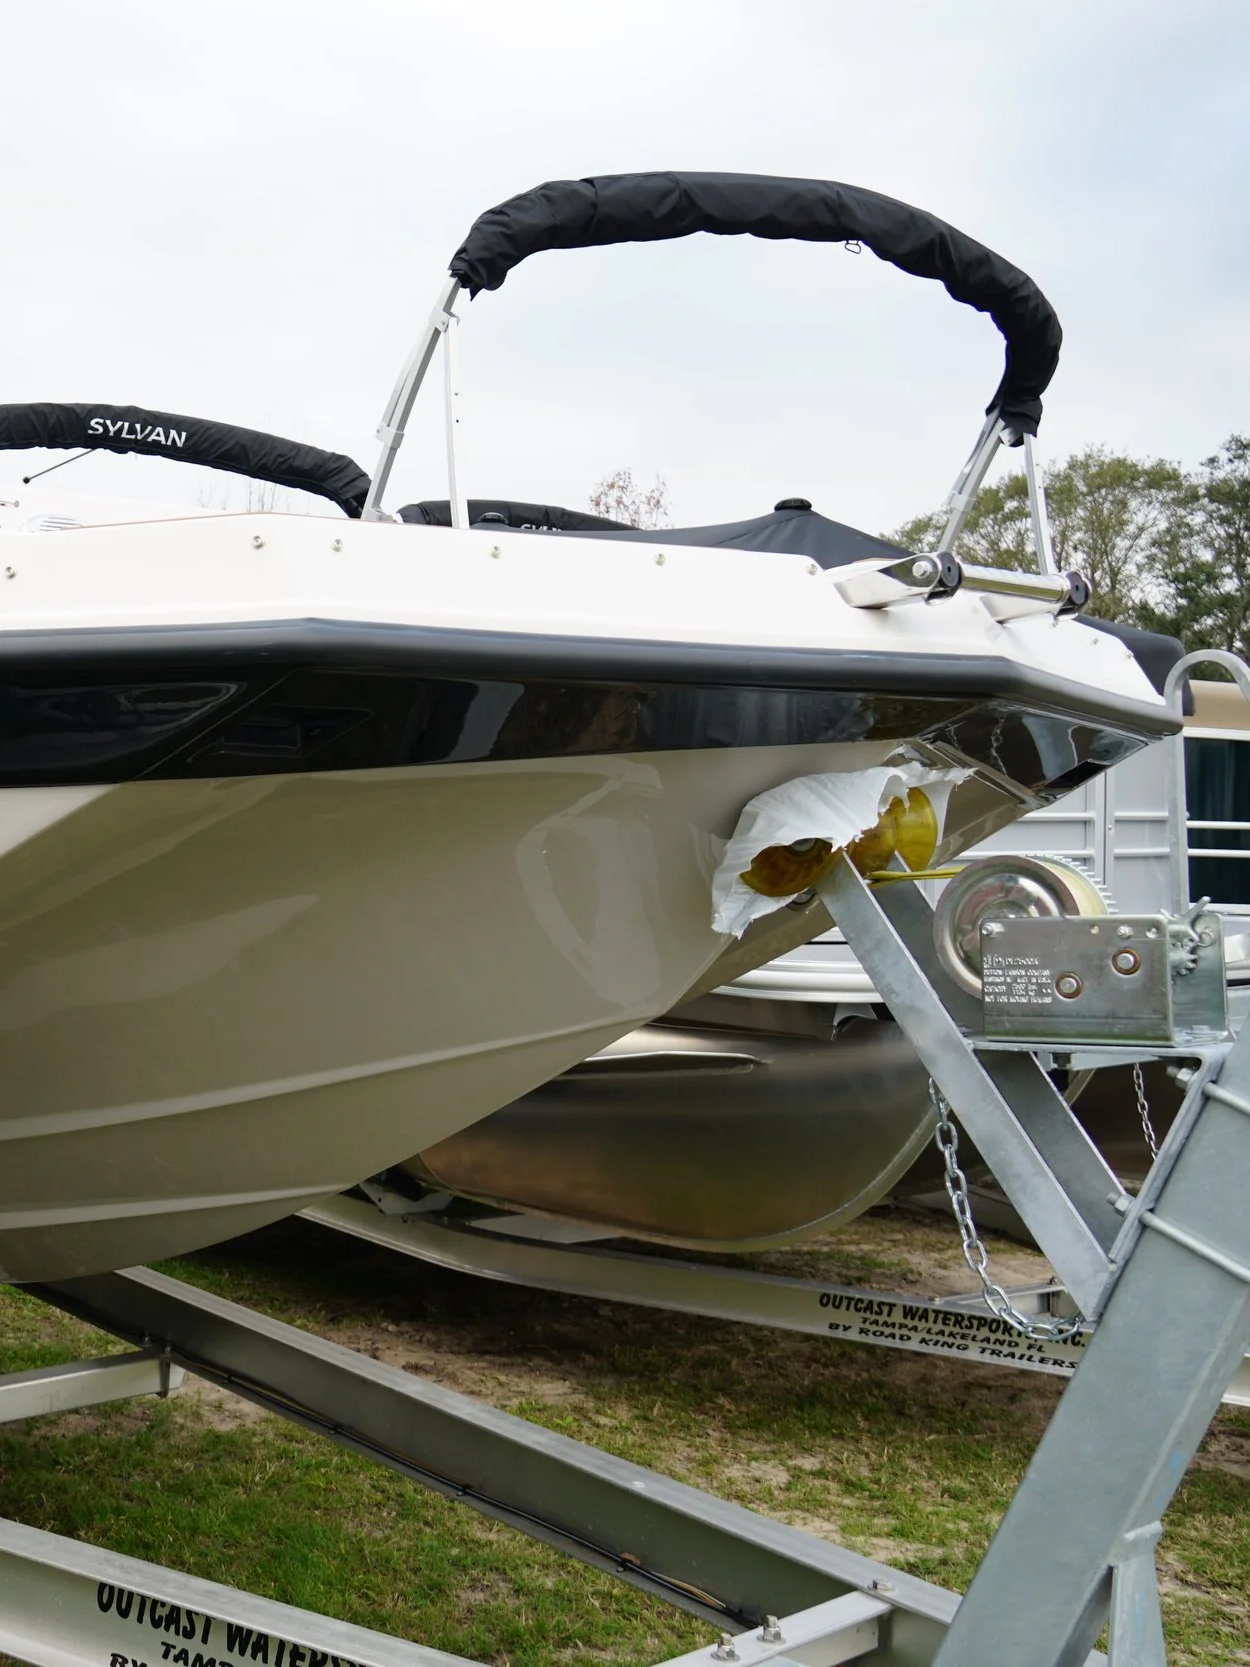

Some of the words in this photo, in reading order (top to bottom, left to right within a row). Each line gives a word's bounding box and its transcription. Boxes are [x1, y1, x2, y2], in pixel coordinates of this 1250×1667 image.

[87, 417, 187, 448] SYLVAN
[819, 1292, 897, 1318] OUTCAST
[828, 1322, 852, 1332] BY
[858, 1327, 912, 1342] ROAD
[918, 1337, 969, 1351] KING
[978, 1345, 1078, 1369] TRAILERS
[861, 1316, 1019, 1348] TAMPA/LAKELAND
[1026, 1342, 1046, 1353] FL
[97, 1582, 215, 1645] OUTCAST
